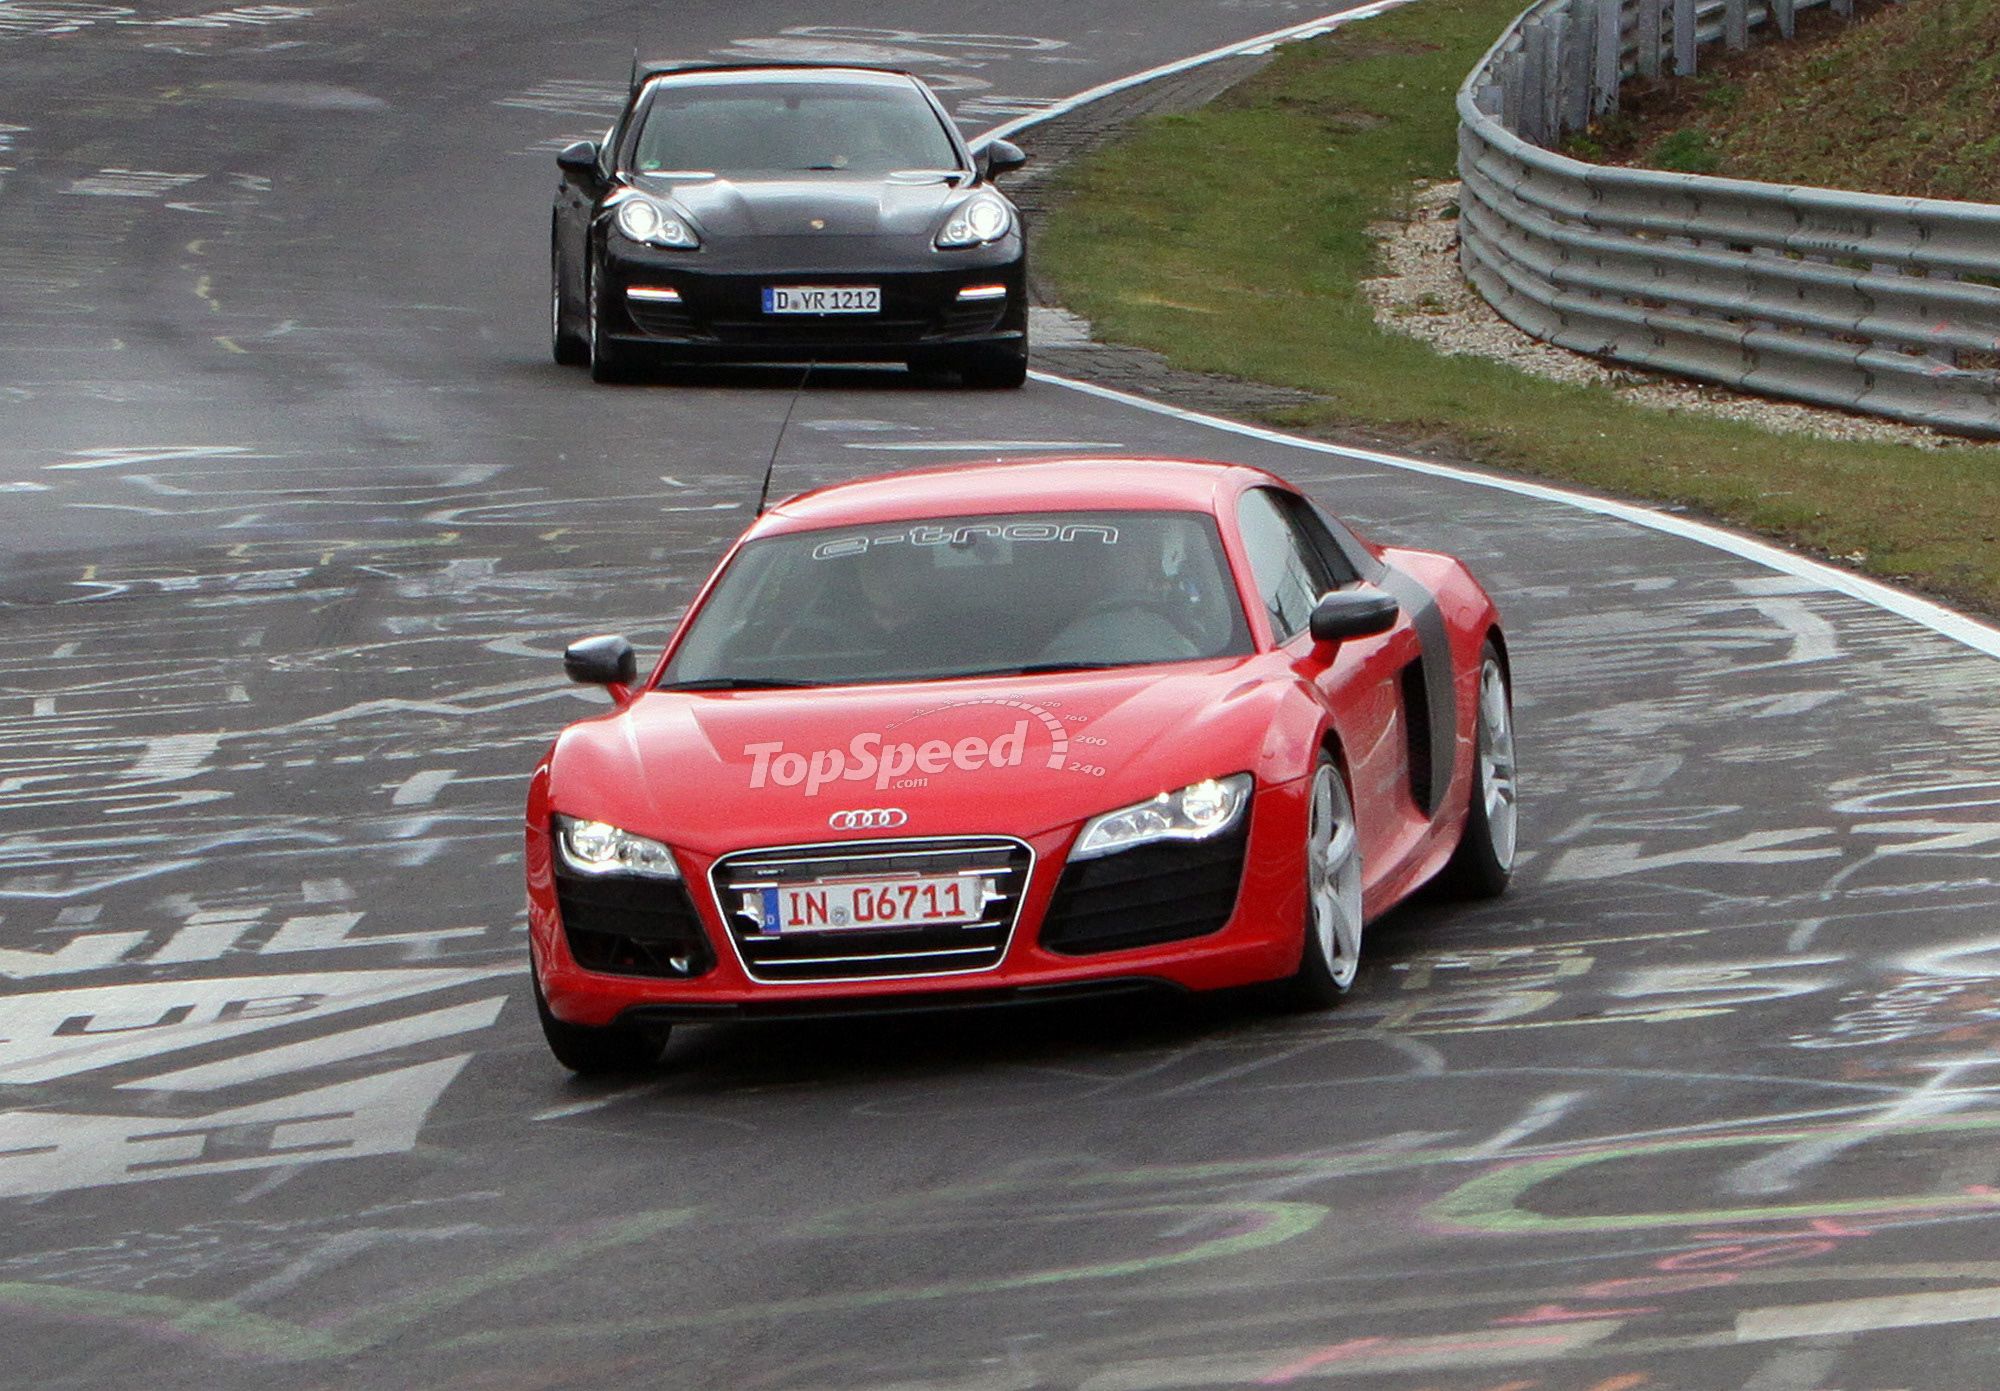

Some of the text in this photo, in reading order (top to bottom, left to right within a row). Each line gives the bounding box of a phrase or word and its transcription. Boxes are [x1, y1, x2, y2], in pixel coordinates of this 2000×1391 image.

[776, 291, 877, 310] D YR 1212
[812, 523, 1119, 560] e-tron
[788, 882, 966, 926] IN 06711
